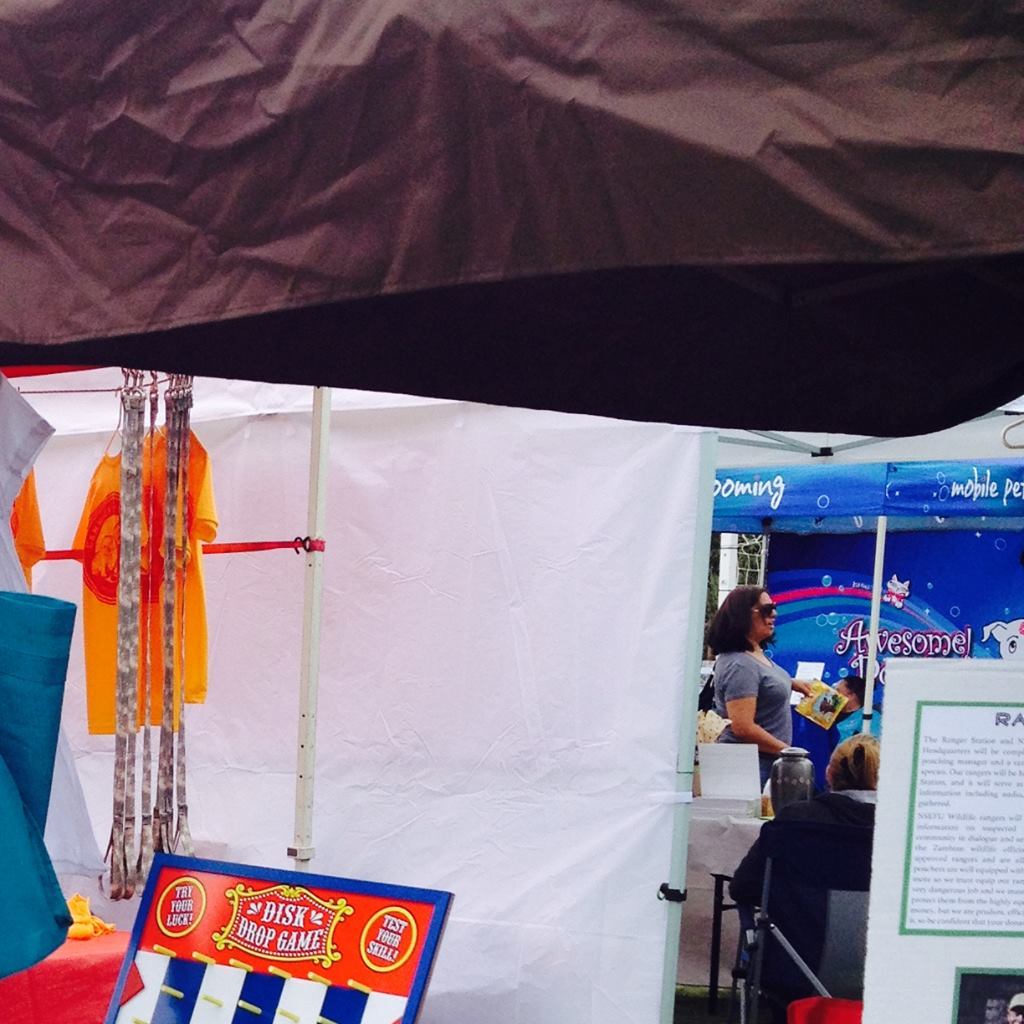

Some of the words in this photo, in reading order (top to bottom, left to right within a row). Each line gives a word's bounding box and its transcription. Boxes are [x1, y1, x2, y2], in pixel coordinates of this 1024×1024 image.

[951, 466, 999, 501] mobile
[175, 886, 192, 898] TRY
[171, 898, 193, 913] YOUR
[262, 900, 309, 928] DISK
[167, 911, 193, 927] LUCK!
[382, 914, 408, 933] TEST
[237, 916, 275, 949] DROP
[277, 927, 325, 952] GAME
[377, 928, 402, 947] YOUR
[366, 942, 398, 963] SKILL!
